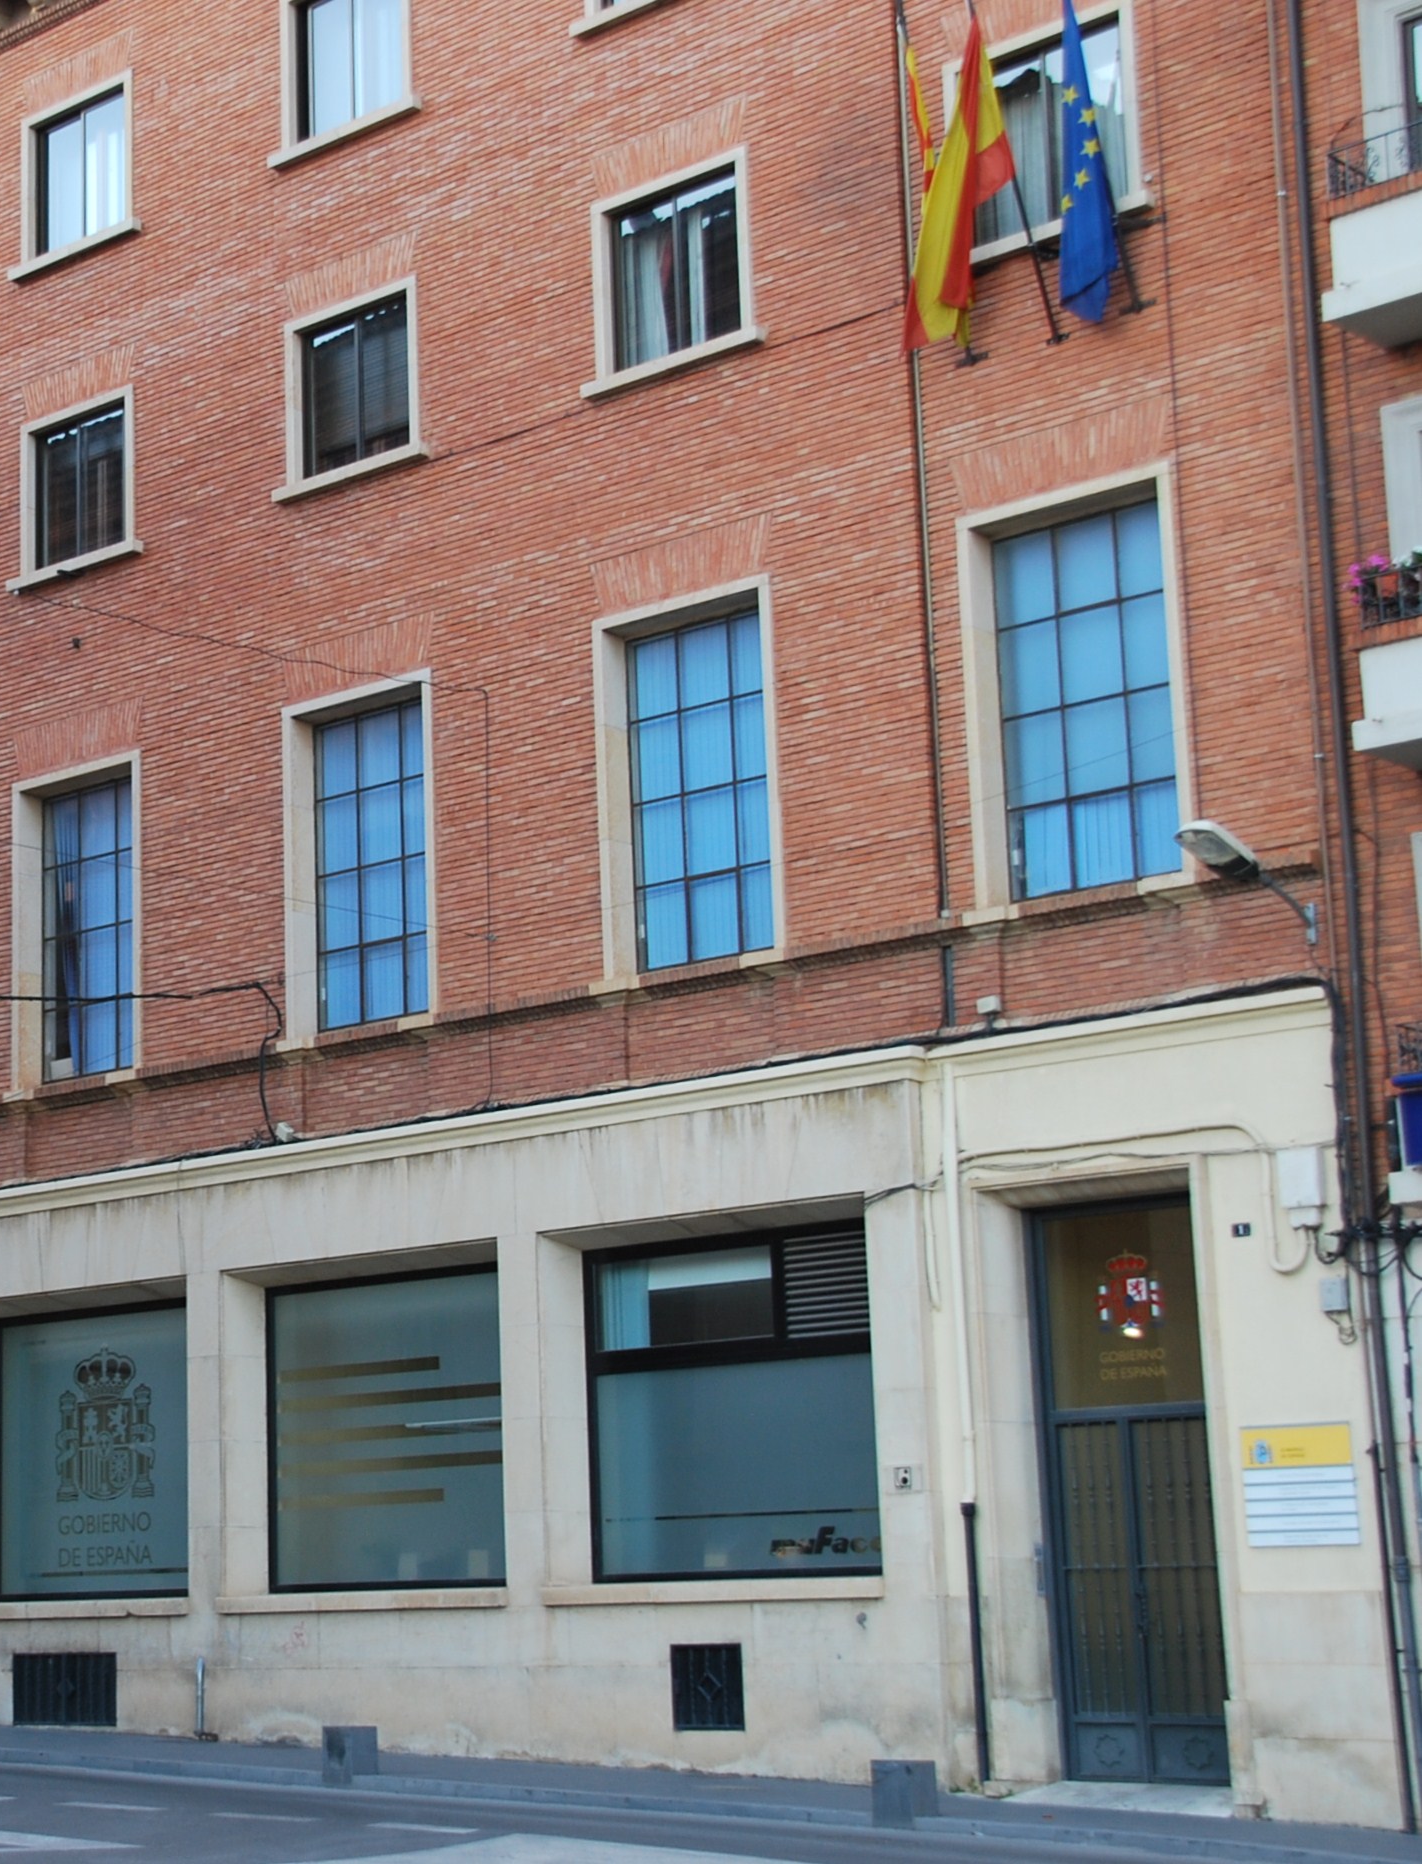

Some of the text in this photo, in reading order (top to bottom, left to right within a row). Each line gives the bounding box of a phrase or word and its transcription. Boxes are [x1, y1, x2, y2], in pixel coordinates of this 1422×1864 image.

[1100, 1347, 1165, 1362] GOBIERNO
[1100, 1363, 1167, 1381] DE ESPAÑA
[58, 1511, 152, 1535] GOBIERNO
[58, 1540, 153, 1567] DE ESPAÑA
